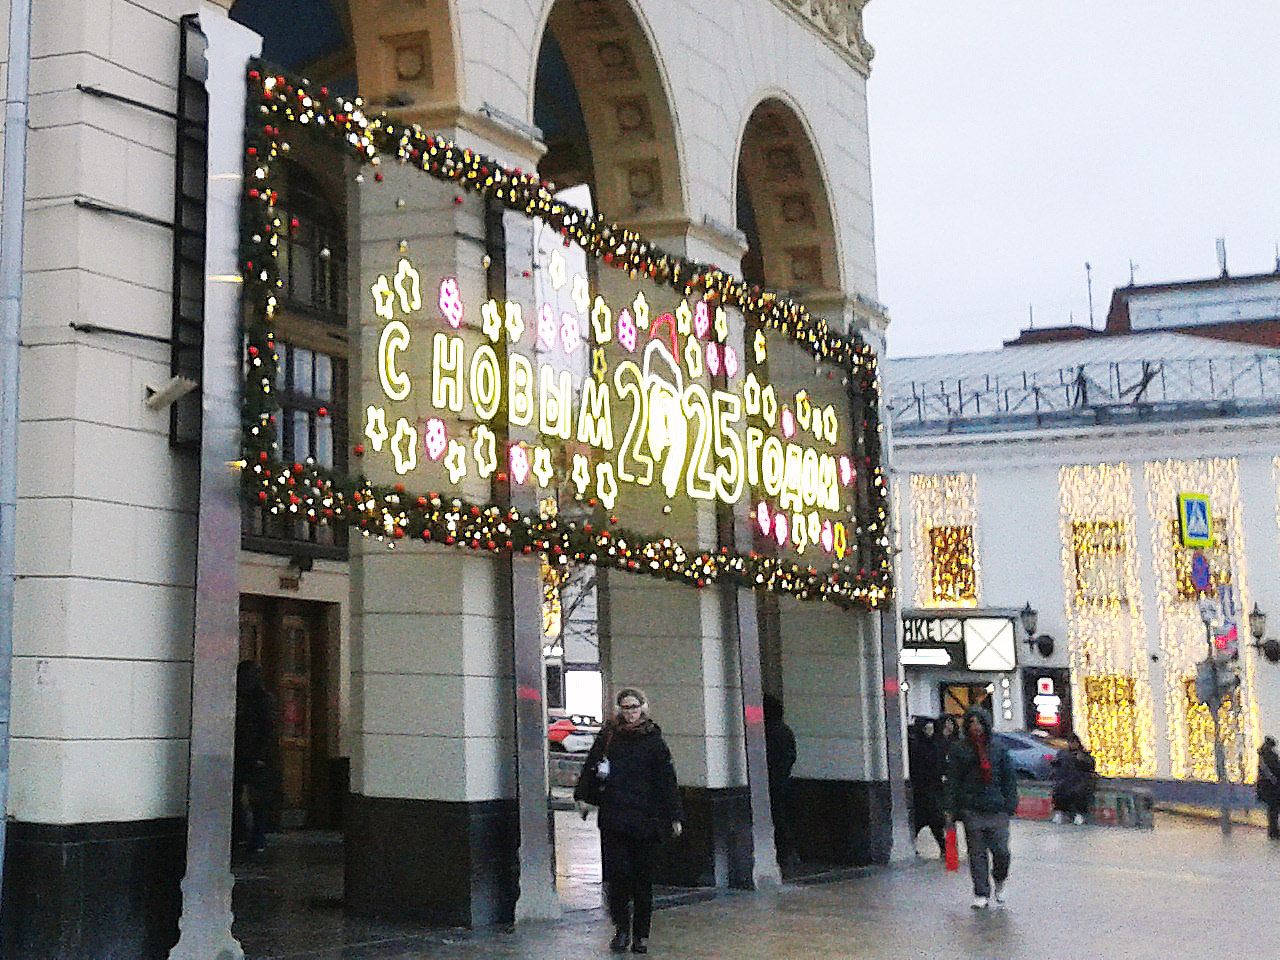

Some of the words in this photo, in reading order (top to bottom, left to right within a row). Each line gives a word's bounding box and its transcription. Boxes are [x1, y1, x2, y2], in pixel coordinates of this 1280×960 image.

[377, 320, 411, 402] С
[431, 332, 614, 450] НОВЫМ
[614, 355, 745, 504] 2025
[746, 426, 840, 513] ГОДОМ
